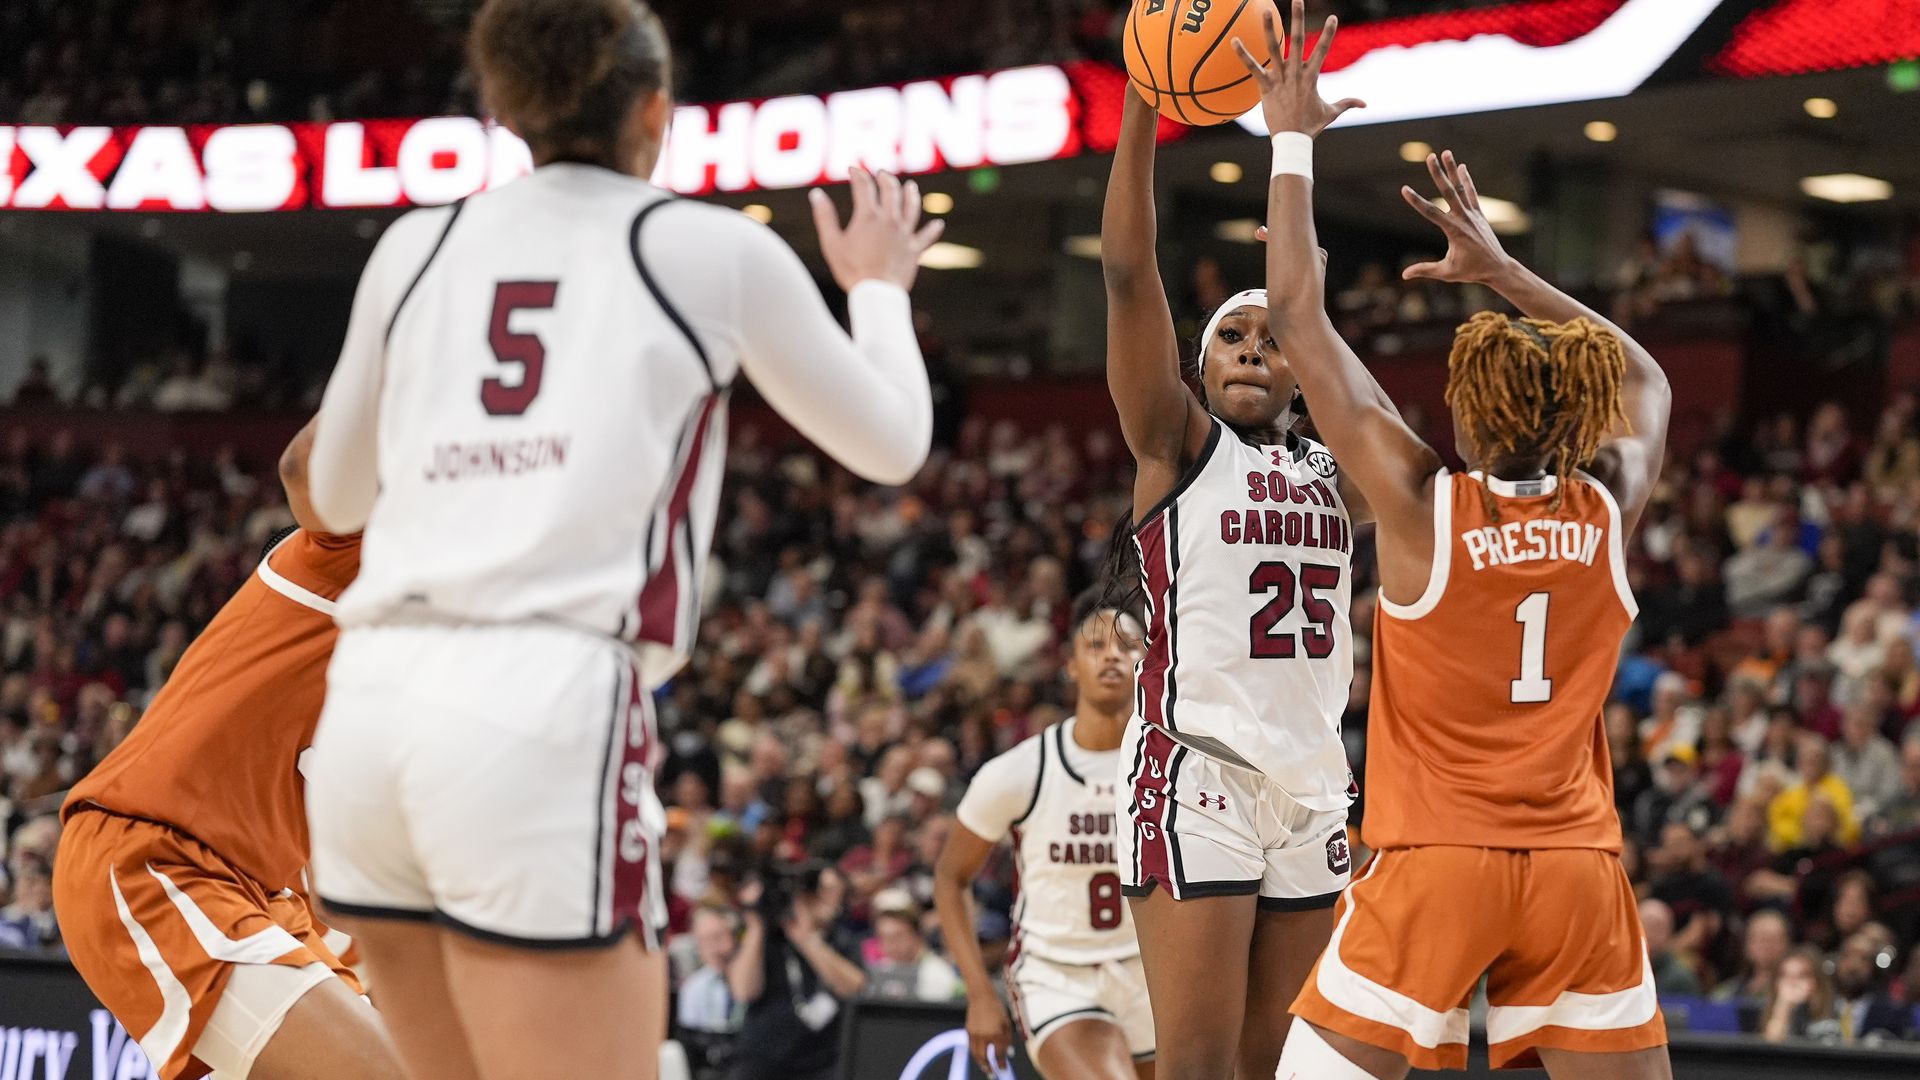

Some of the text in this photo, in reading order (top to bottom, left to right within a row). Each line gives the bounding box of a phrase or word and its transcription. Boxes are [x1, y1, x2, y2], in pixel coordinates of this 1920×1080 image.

[0, 65, 1071, 212] XAS LOHORNS
[480, 280, 558, 415] 5
[424, 434, 572, 482] JOHNSON
[1308, 453, 1336, 476] SEC
[1220, 509, 1350, 555] CAROLINA
[1461, 519, 1604, 571] PRESTON
[1249, 561, 1340, 659] 25
[1510, 590, 1552, 703] 1
[1069, 813, 1117, 836] SOU
[1089, 871, 1122, 930] 8
